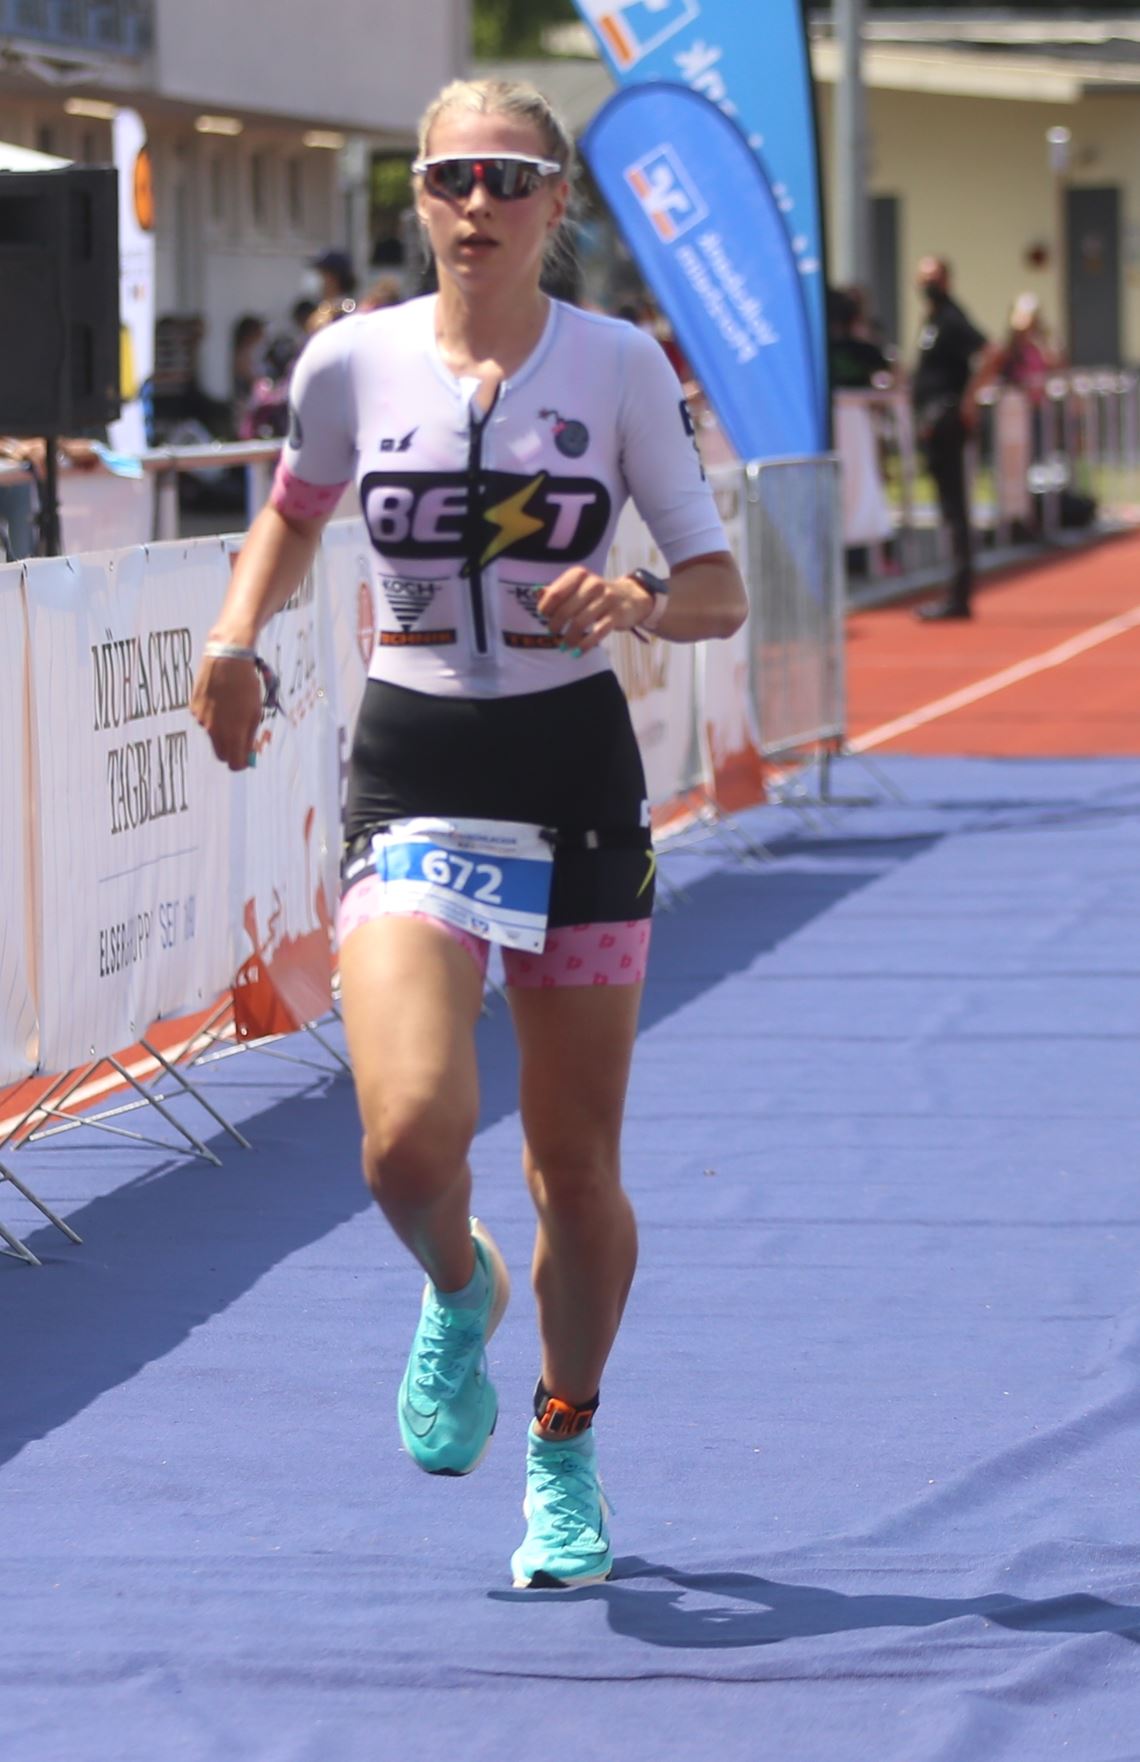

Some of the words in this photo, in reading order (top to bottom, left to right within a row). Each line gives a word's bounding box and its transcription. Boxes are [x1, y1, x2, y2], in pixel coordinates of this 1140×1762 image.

[382, 578, 435, 595] KOCH
[92, 627, 194, 730] MÜHLACKER
[108, 731, 188, 835] TAGBLATT
[422, 850, 503, 905] 672
